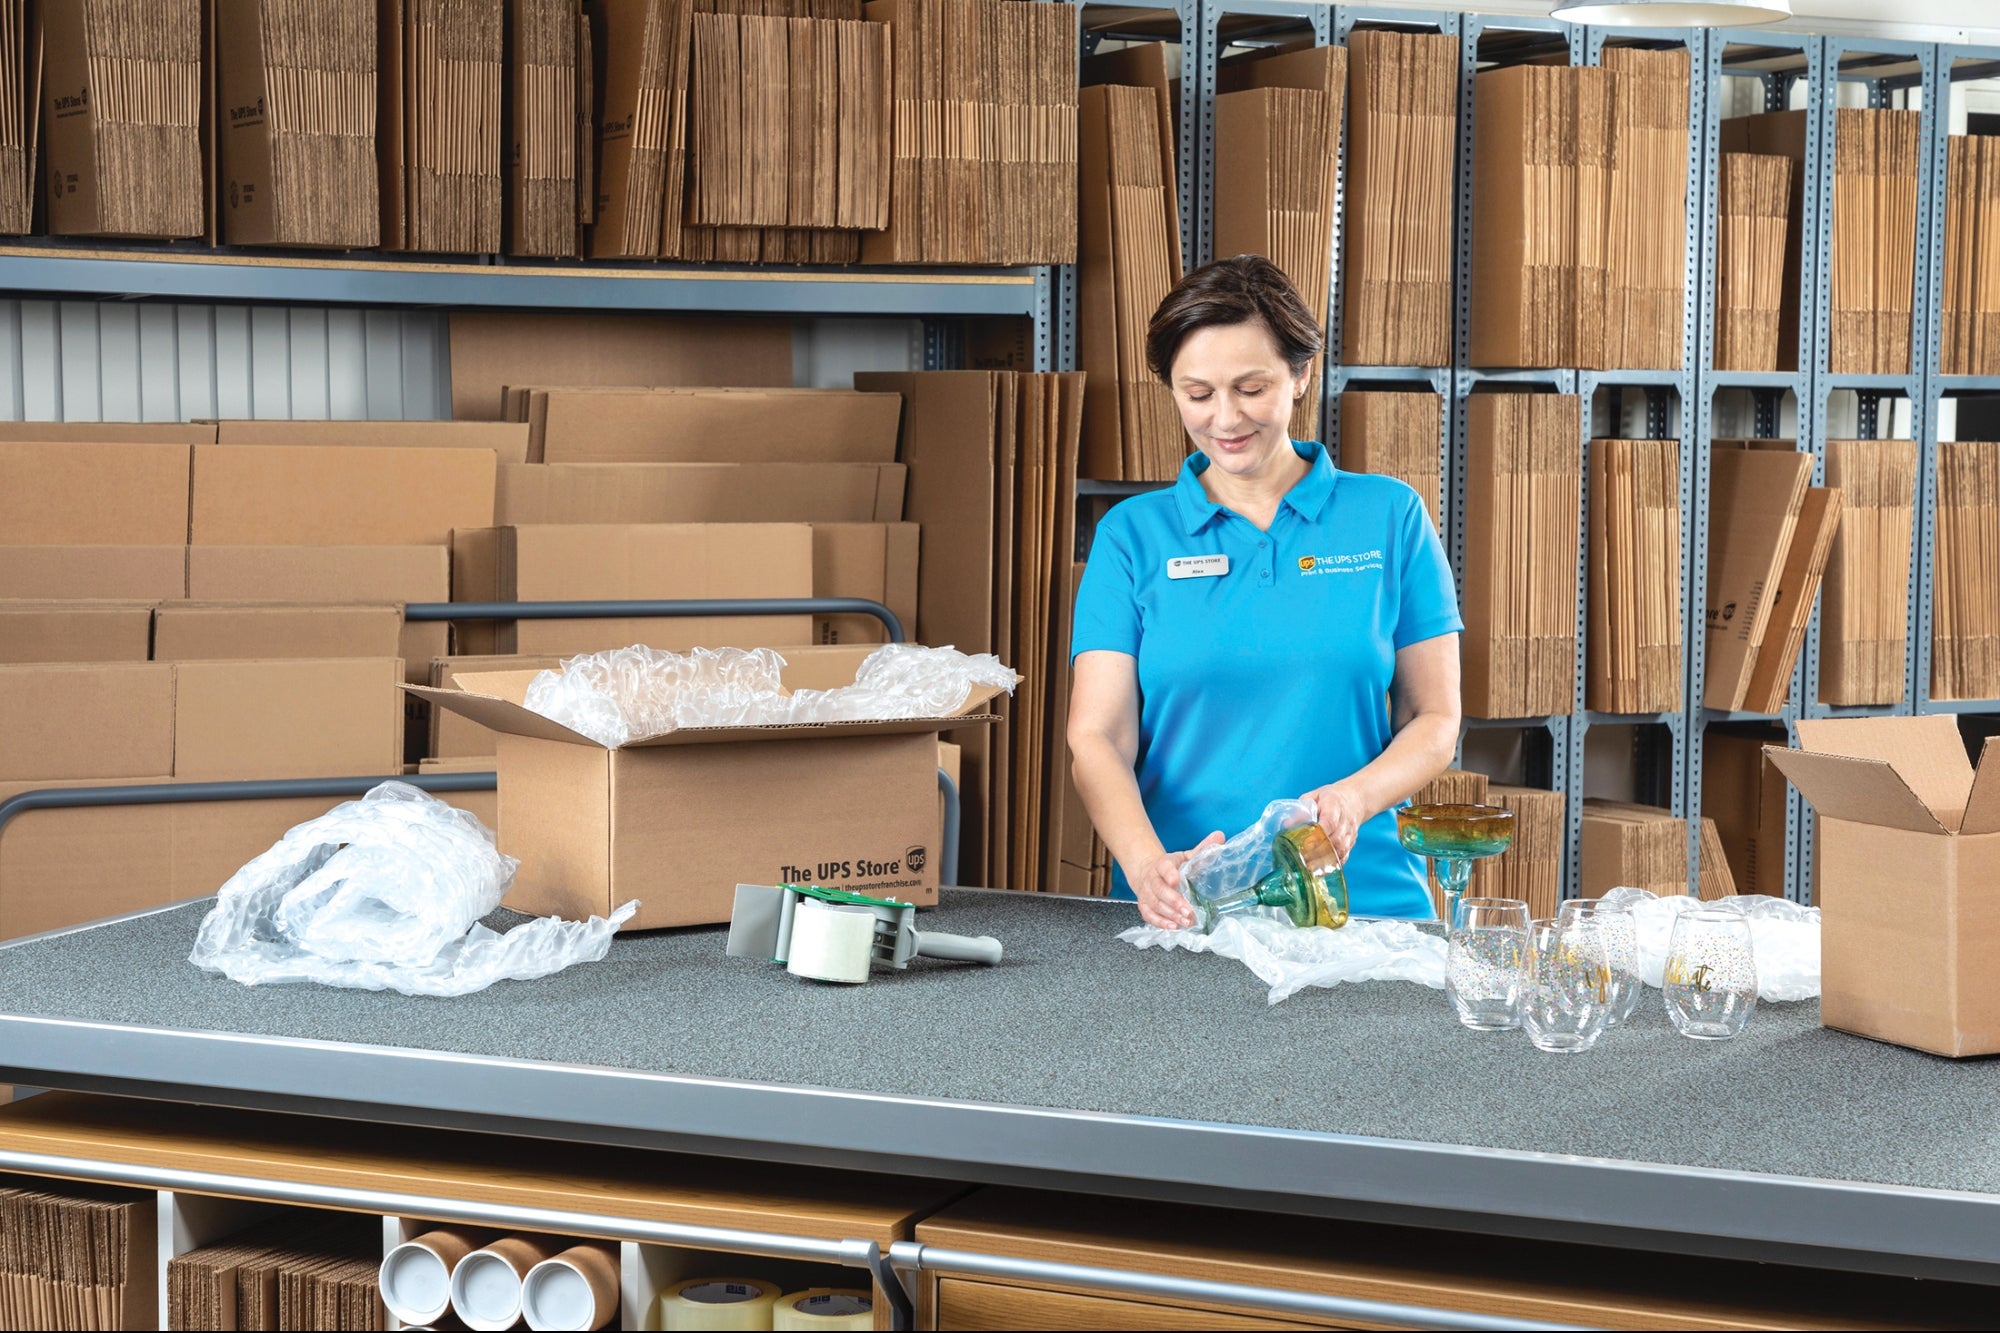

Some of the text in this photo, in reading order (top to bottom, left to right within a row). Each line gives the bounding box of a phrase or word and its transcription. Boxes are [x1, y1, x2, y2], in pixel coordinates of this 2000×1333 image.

[1316, 550, 1382, 565] THE UPS STORE
[1301, 569, 1317, 577] Print
[1355, 563, 1383, 572] Services
[781, 859, 900, 883] The UPS Store
[845, 879, 922, 892] theupsstorefranchise.com
